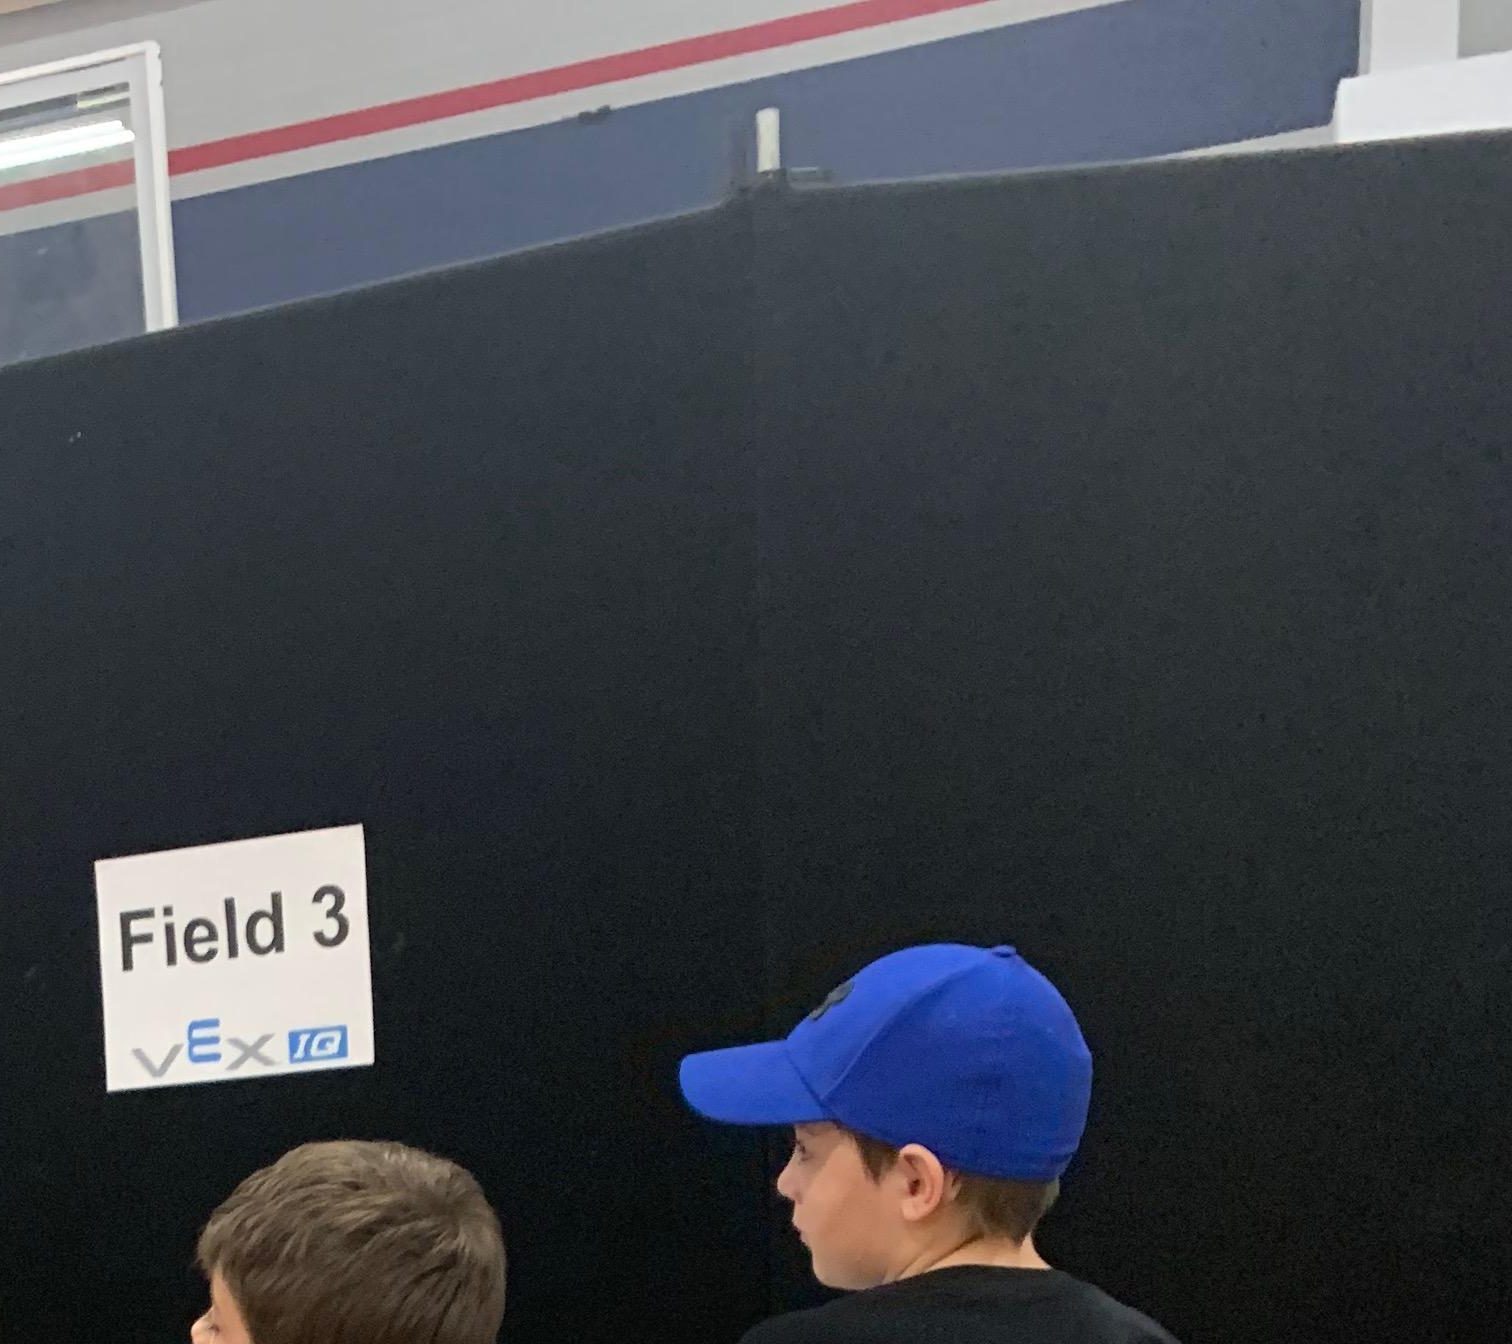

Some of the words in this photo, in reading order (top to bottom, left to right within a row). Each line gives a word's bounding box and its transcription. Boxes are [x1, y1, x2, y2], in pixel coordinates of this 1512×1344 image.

[119, 890, 285, 972] Field
[312, 884, 350, 947] 3
[131, 1018, 278, 1077] VEX
[291, 1029, 343, 1061] IQ
